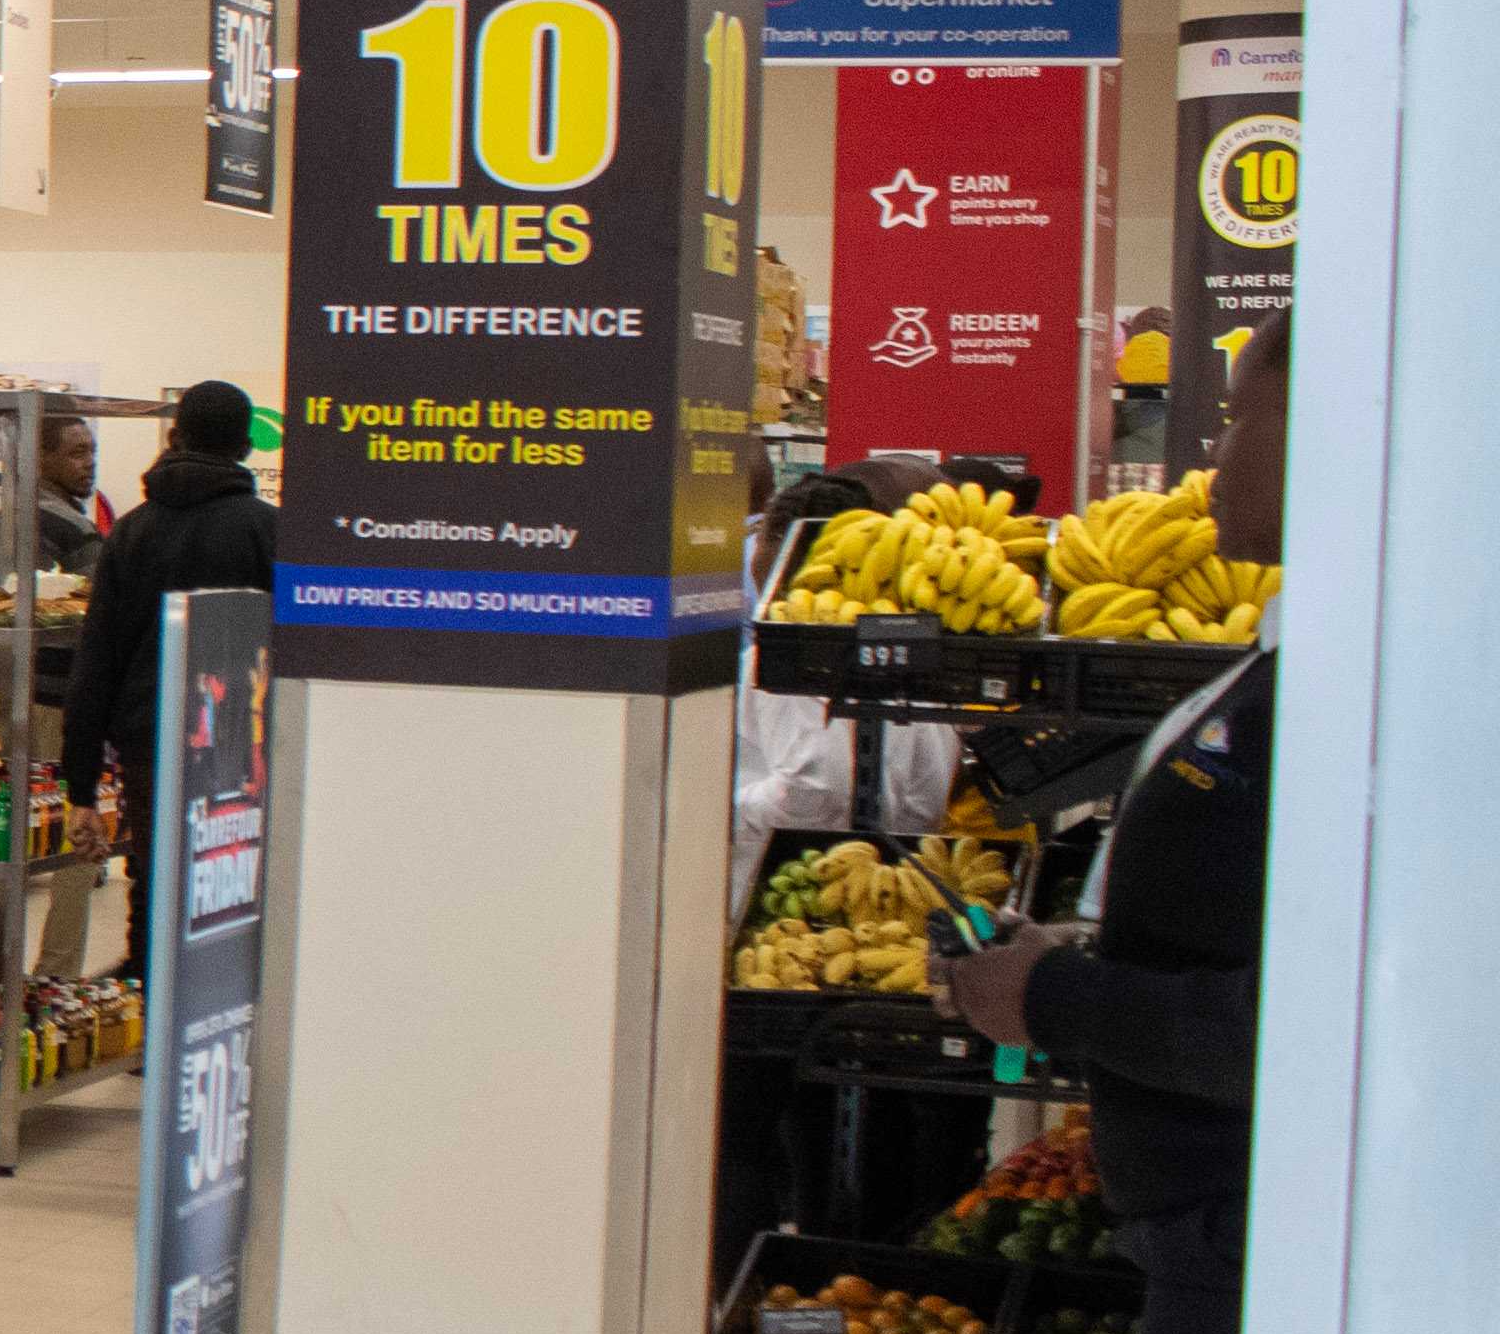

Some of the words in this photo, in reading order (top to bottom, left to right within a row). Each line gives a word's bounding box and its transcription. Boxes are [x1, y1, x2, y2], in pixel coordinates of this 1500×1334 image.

[762, 27, 818, 44] Thank
[820, 30, 857, 47] you
[859, 27, 888, 43] for
[892, 29, 939, 47] your
[941, 28, 1070, 47] co-operation
[950, 175, 1010, 194] EARN
[949, 196, 997, 212] points
[998, 197, 1039, 213] every
[1244, 203, 1285, 217] TIMES
[949, 212, 983, 226] time
[983, 214, 1012, 229] you
[1011, 213, 1051, 228] shop
[377, 203, 593, 265] TIMES
[1231, 274, 1263, 288] ARE
[1216, 296, 1238, 310] TO
[322, 305, 399, 334] THE
[404, 305, 644, 338] DIFFERENCE
[949, 314, 1040, 332] REDEEM
[950, 336, 986, 351] your
[986, 335, 1032, 350] points
[951, 351, 1017, 368] instantly
[305, 397, 333, 425] If
[339, 403, 404, 433] you
[412, 397, 480, 427] find
[489, 399, 546, 429] the
[553, 407, 654, 432] same
[368, 433, 444, 462] item
[452, 435, 504, 464] for
[512, 435, 586, 466] less
[353, 516, 495, 542] Conditions
[499, 521, 578, 549] Apply
[345, 586, 423, 609] PRICES
[509, 593, 576, 614] MUCH
[193, 845, 257, 919] FRIDAY
